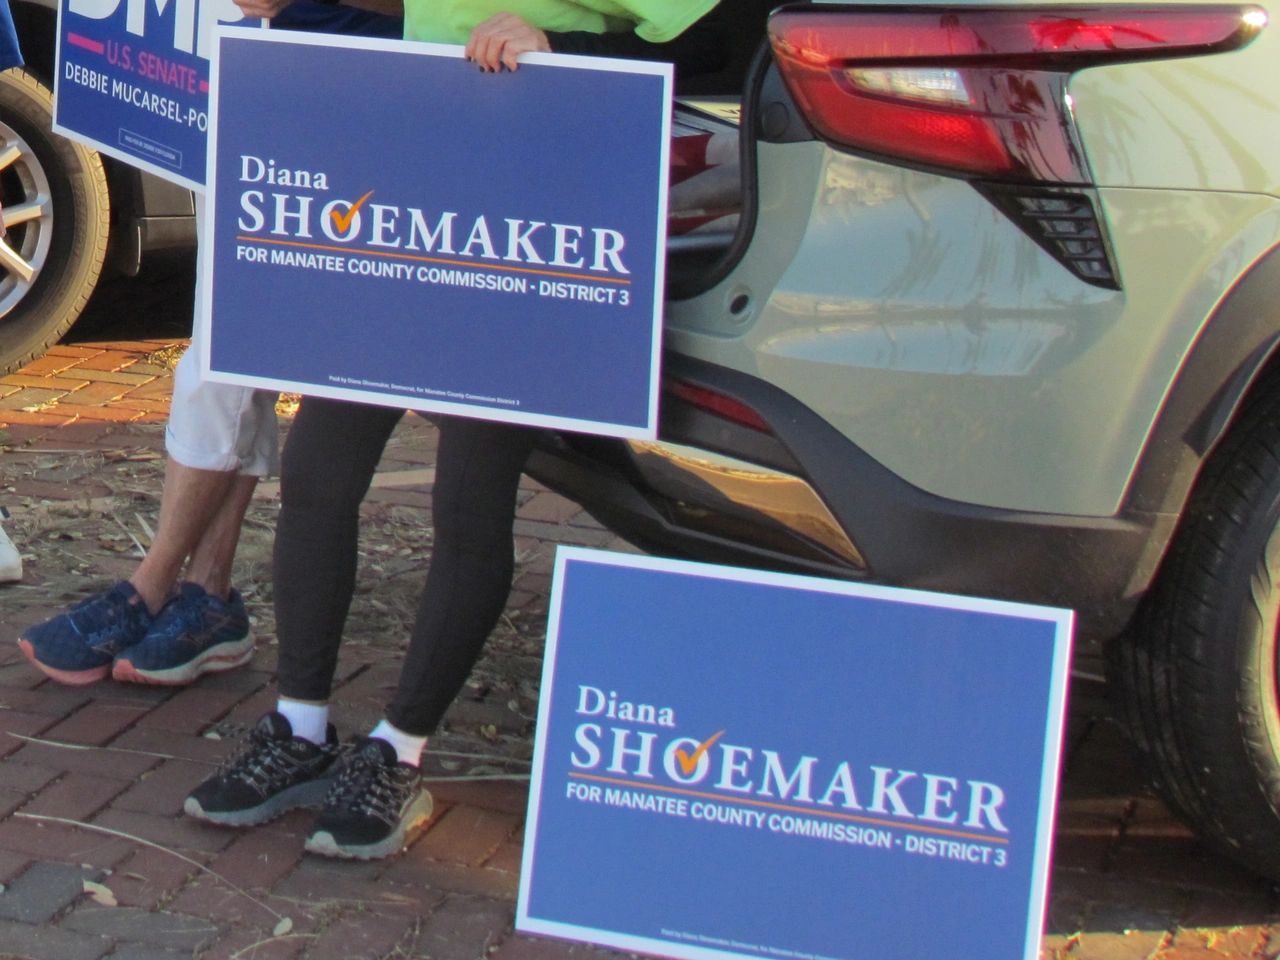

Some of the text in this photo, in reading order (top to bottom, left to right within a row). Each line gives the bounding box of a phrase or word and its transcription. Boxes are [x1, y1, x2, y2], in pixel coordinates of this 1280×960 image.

[65, 60, 109, 94] DEBBIE
[107, 39, 198, 95] U.S. SENATE
[239, 154, 329, 191] Diana
[237, 190, 631, 274] SHOEMAKER
[236, 245, 268, 264] FOR
[270, 249, 345, 273] MANATEE
[348, 258, 415, 281] COUNTY
[417, 266, 528, 293] COMMISSION
[539, 281, 616, 305] DISTRICT
[618, 290, 630, 306] 3
[575, 685, 676, 727] Diana
[569, 721, 1009, 832] SHOEMAKER
[566, 781, 602, 803] FOR
[604, 788, 688, 817] MANATEE
[690, 800, 767, 829] COUNTY
[768, 812, 892, 849] COMMISSION
[905, 836, 992, 865] DISTRICT
[994, 848, 1008, 868] 3
